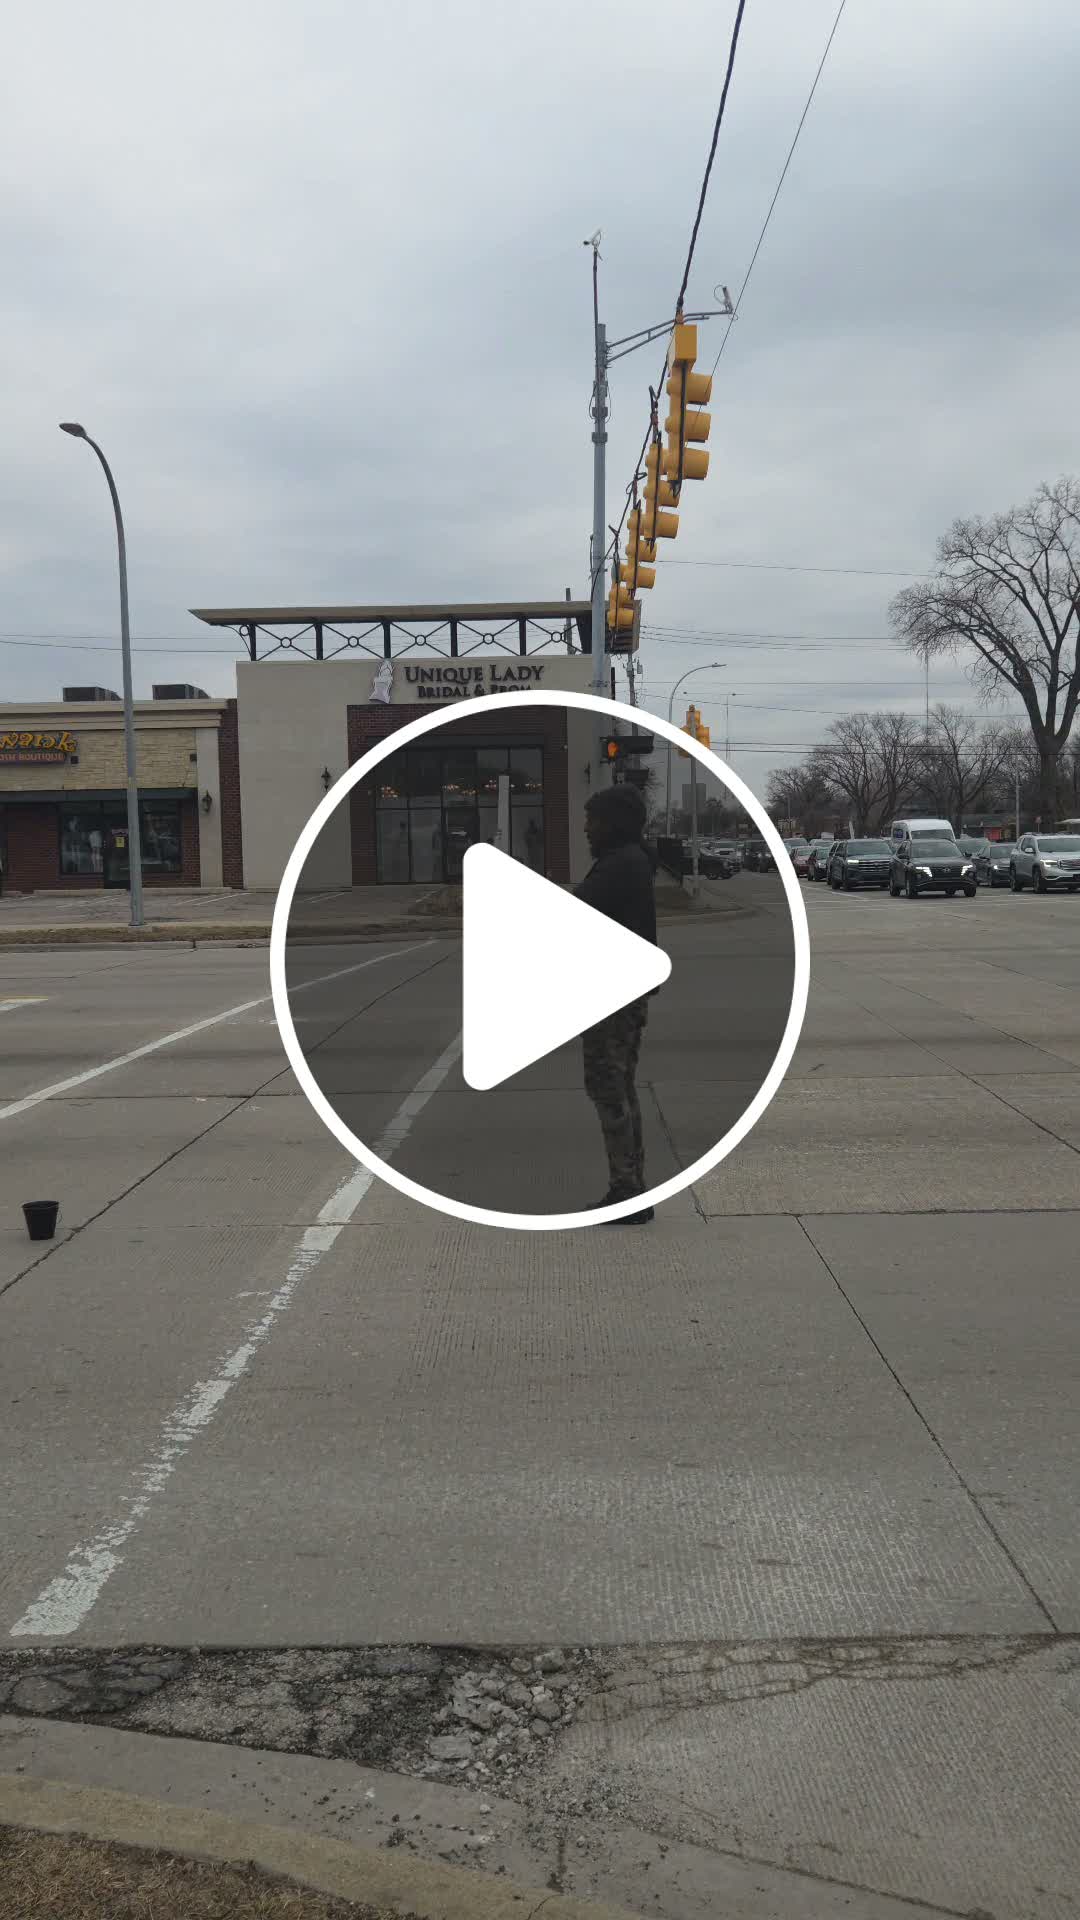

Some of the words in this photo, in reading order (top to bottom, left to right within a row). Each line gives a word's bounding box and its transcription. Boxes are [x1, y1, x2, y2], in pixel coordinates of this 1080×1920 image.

[404, 666, 483, 684] UNIQUE
[490, 665, 544, 681] LADY
[418, 686, 471, 698] BRIDAL
[474, 684, 485, 696] &
